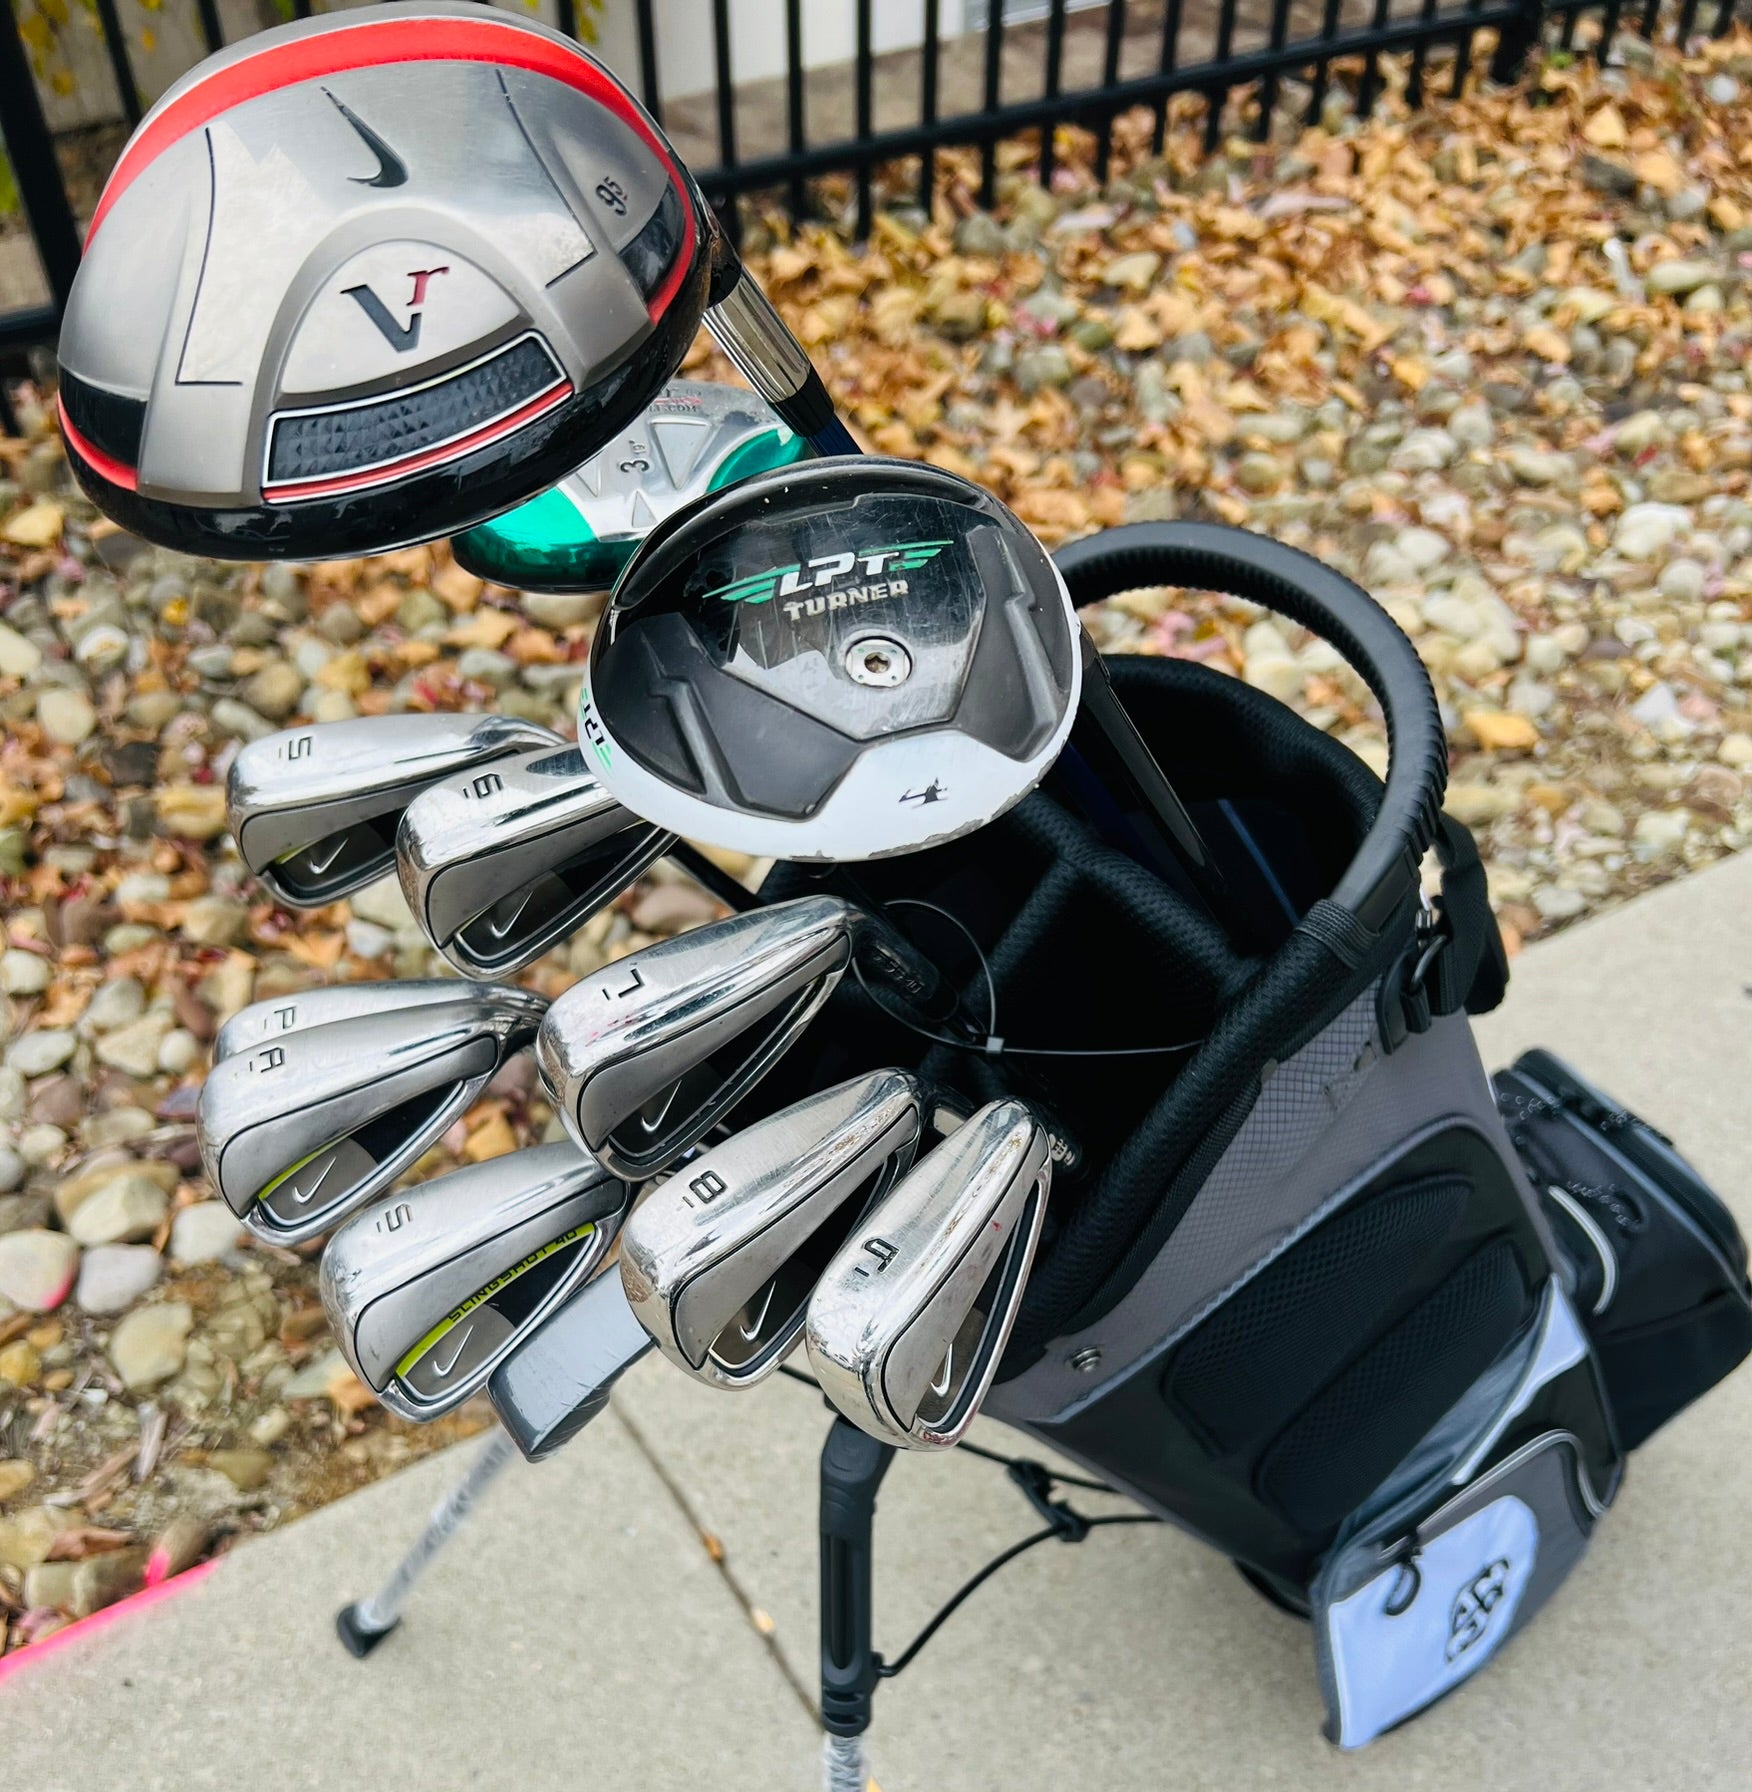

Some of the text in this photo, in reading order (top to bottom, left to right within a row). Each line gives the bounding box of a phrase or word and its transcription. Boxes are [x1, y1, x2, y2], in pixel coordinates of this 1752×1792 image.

[620, 459, 650, 473] 3
[783, 579, 910, 622] TURNER
[288, 736, 314, 761] 5
[472, 772, 504, 800] 6
[617, 967, 646, 999] 7
[273, 1005, 297, 1030] P
[259, 1046, 286, 1074] A
[688, 1169, 729, 1205] 8
[863, 1237, 901, 1273] 9
[448, 1228, 579, 1323] SLINGSHOT 40
